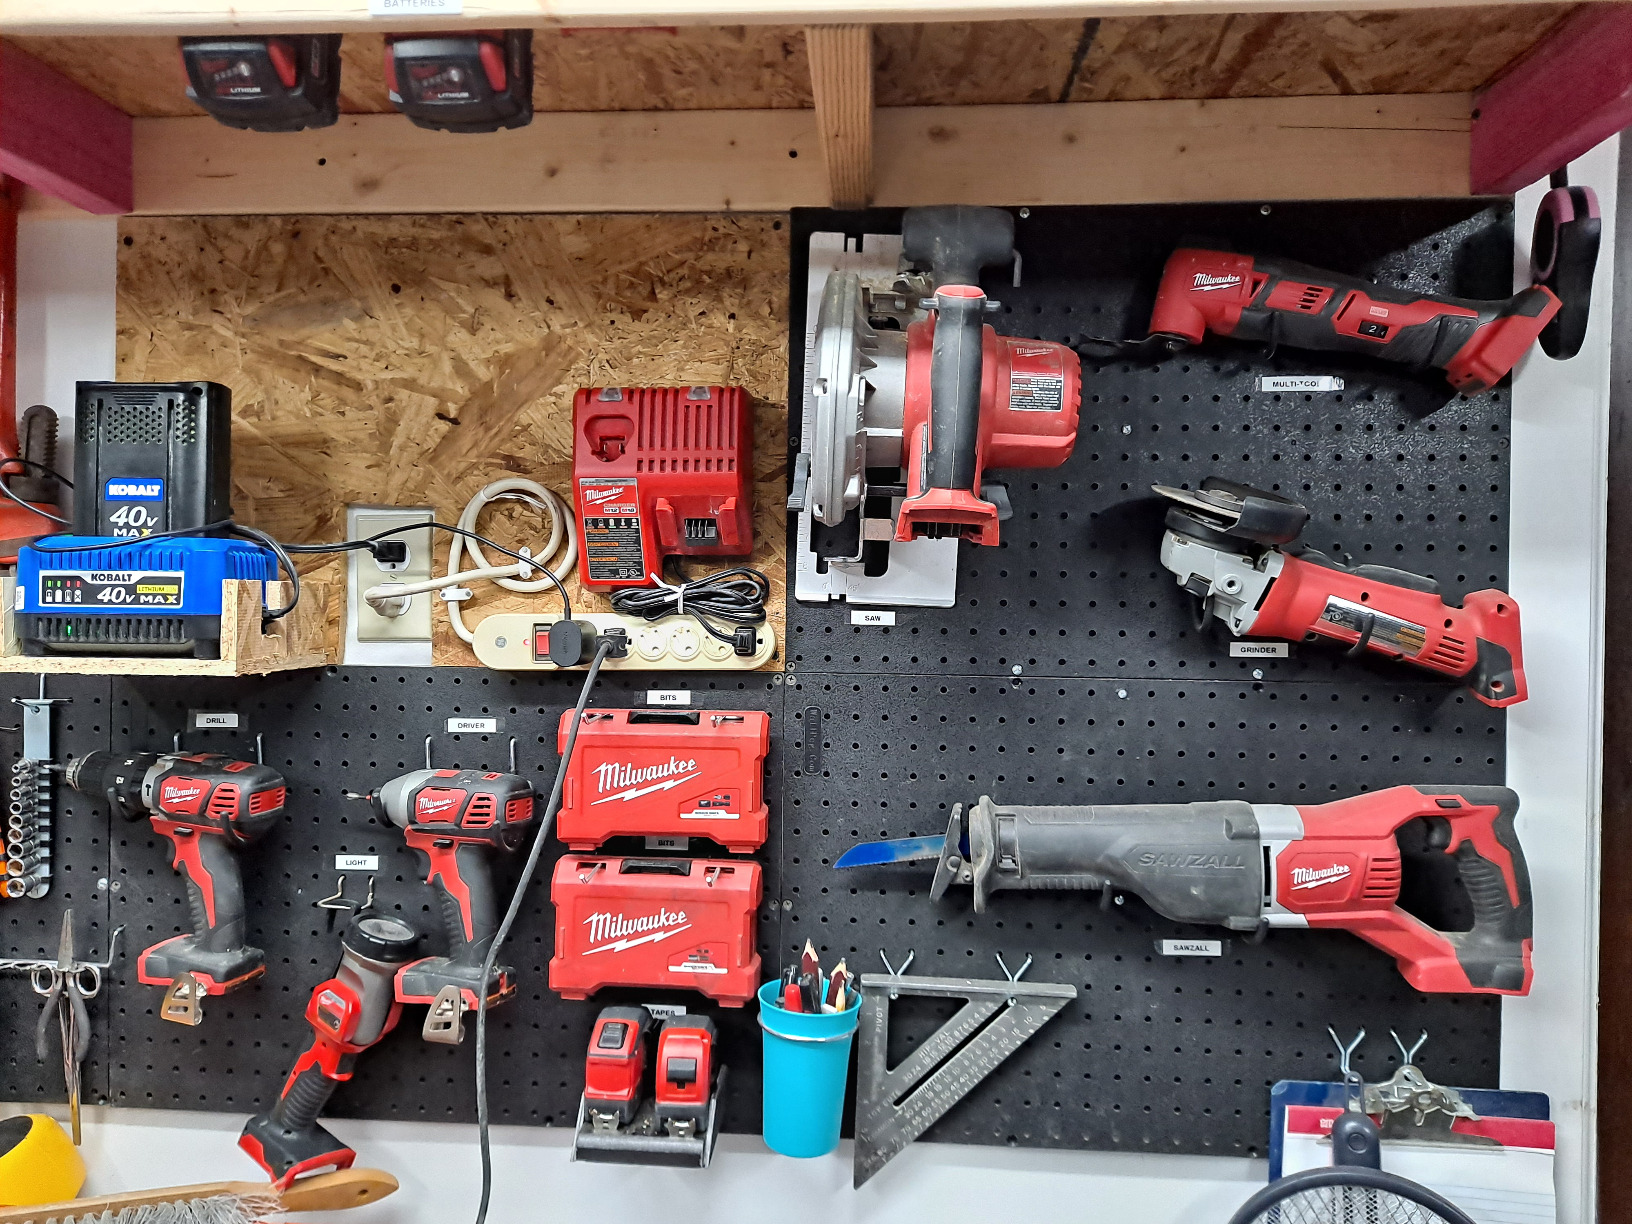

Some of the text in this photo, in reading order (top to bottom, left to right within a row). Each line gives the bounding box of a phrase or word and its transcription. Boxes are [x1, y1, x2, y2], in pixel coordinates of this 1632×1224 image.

[384, 0, 445, 8] BATTERIES
[1193, 273, 1240, 286] Milwaukee
[1369, 325, 1377, 333] 2
[108, 484, 161, 496] KOBALT
[584, 487, 624, 502] Milwaukee
[113, 528, 153, 537] MAX
[91, 573, 132, 582] KOBALT
[140, 595, 178, 603] MAX
[591, 756, 698, 793] Milwaukee
[164, 786, 200, 799] Milwaukee
[1138, 852, 1245, 869] SAWZALL
[1291, 864, 1350, 884] Milwaukee
[583, 908, 687, 943] Milwaukee
[651, 1008, 675, 1016] TAPES
[875, 1006, 883, 1033] PIVOT
